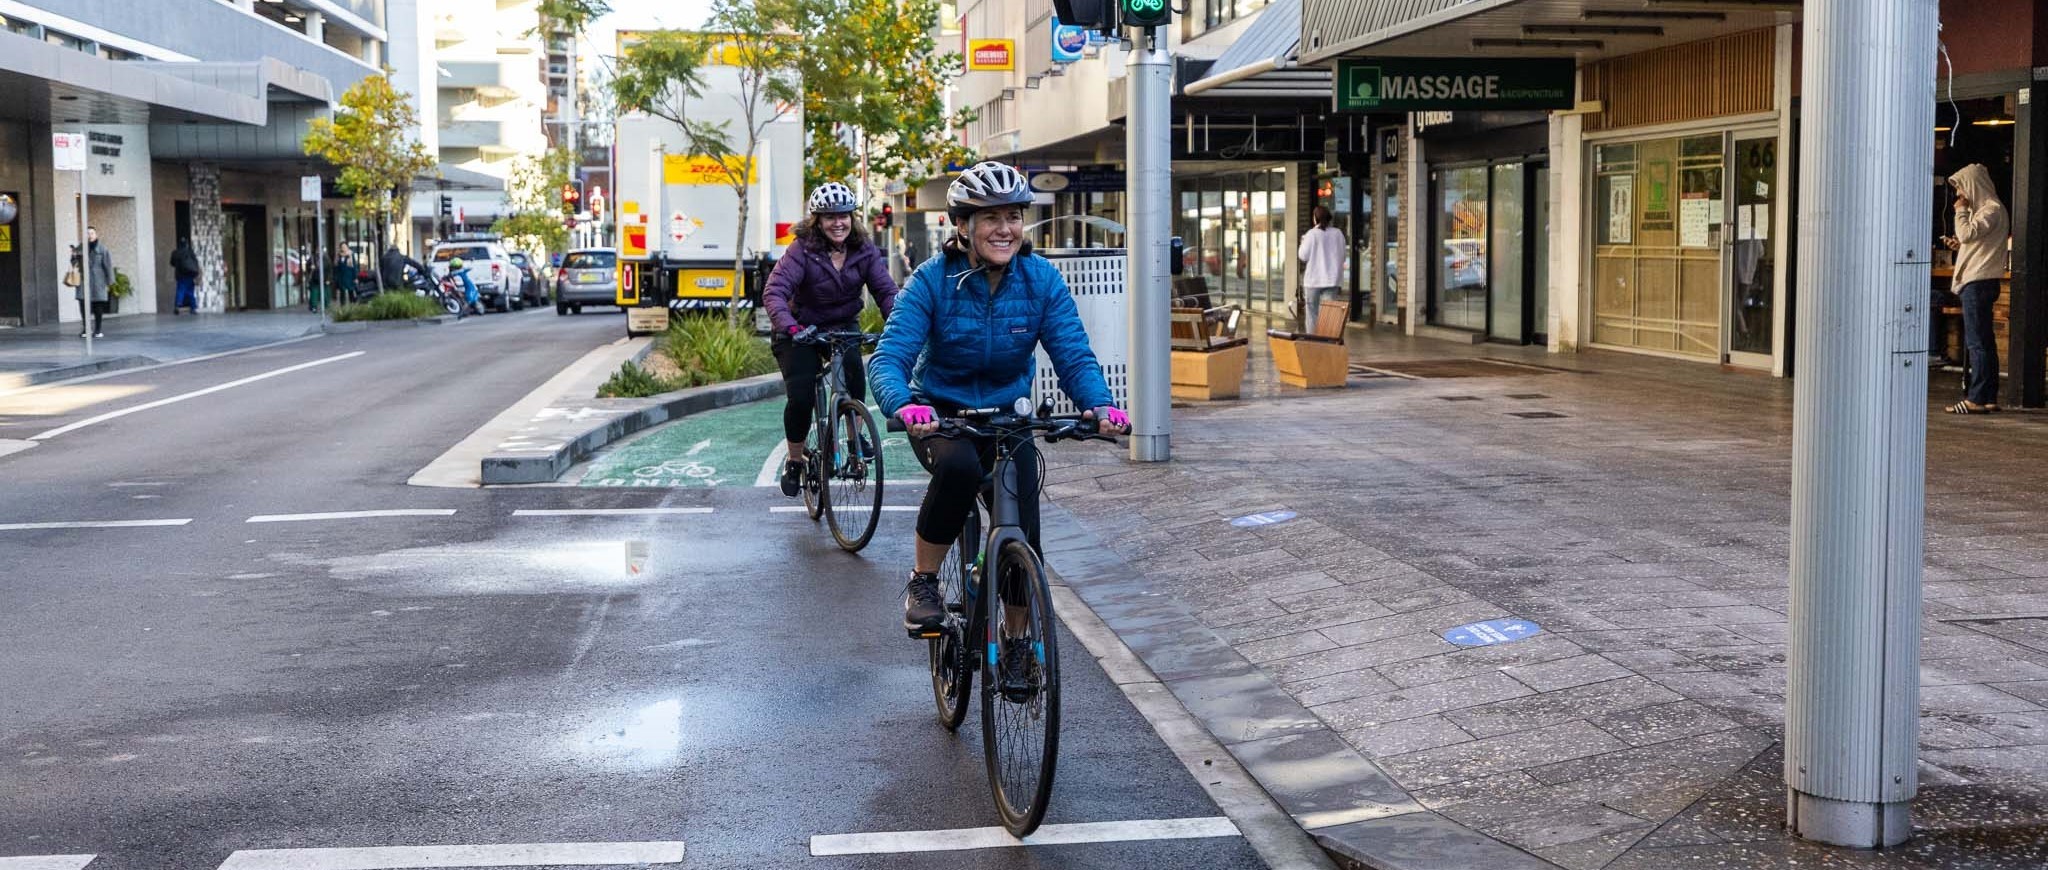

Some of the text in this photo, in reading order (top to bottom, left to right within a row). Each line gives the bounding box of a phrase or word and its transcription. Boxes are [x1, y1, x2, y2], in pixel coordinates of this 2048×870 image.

[975, 50, 1008, 59] CHEMIST
[1381, 75, 1499, 100] MASSAGE
[1385, 135, 1398, 158] 60
[1750, 141, 1774, 168] 66
[598, 478, 728, 487] ONLY
